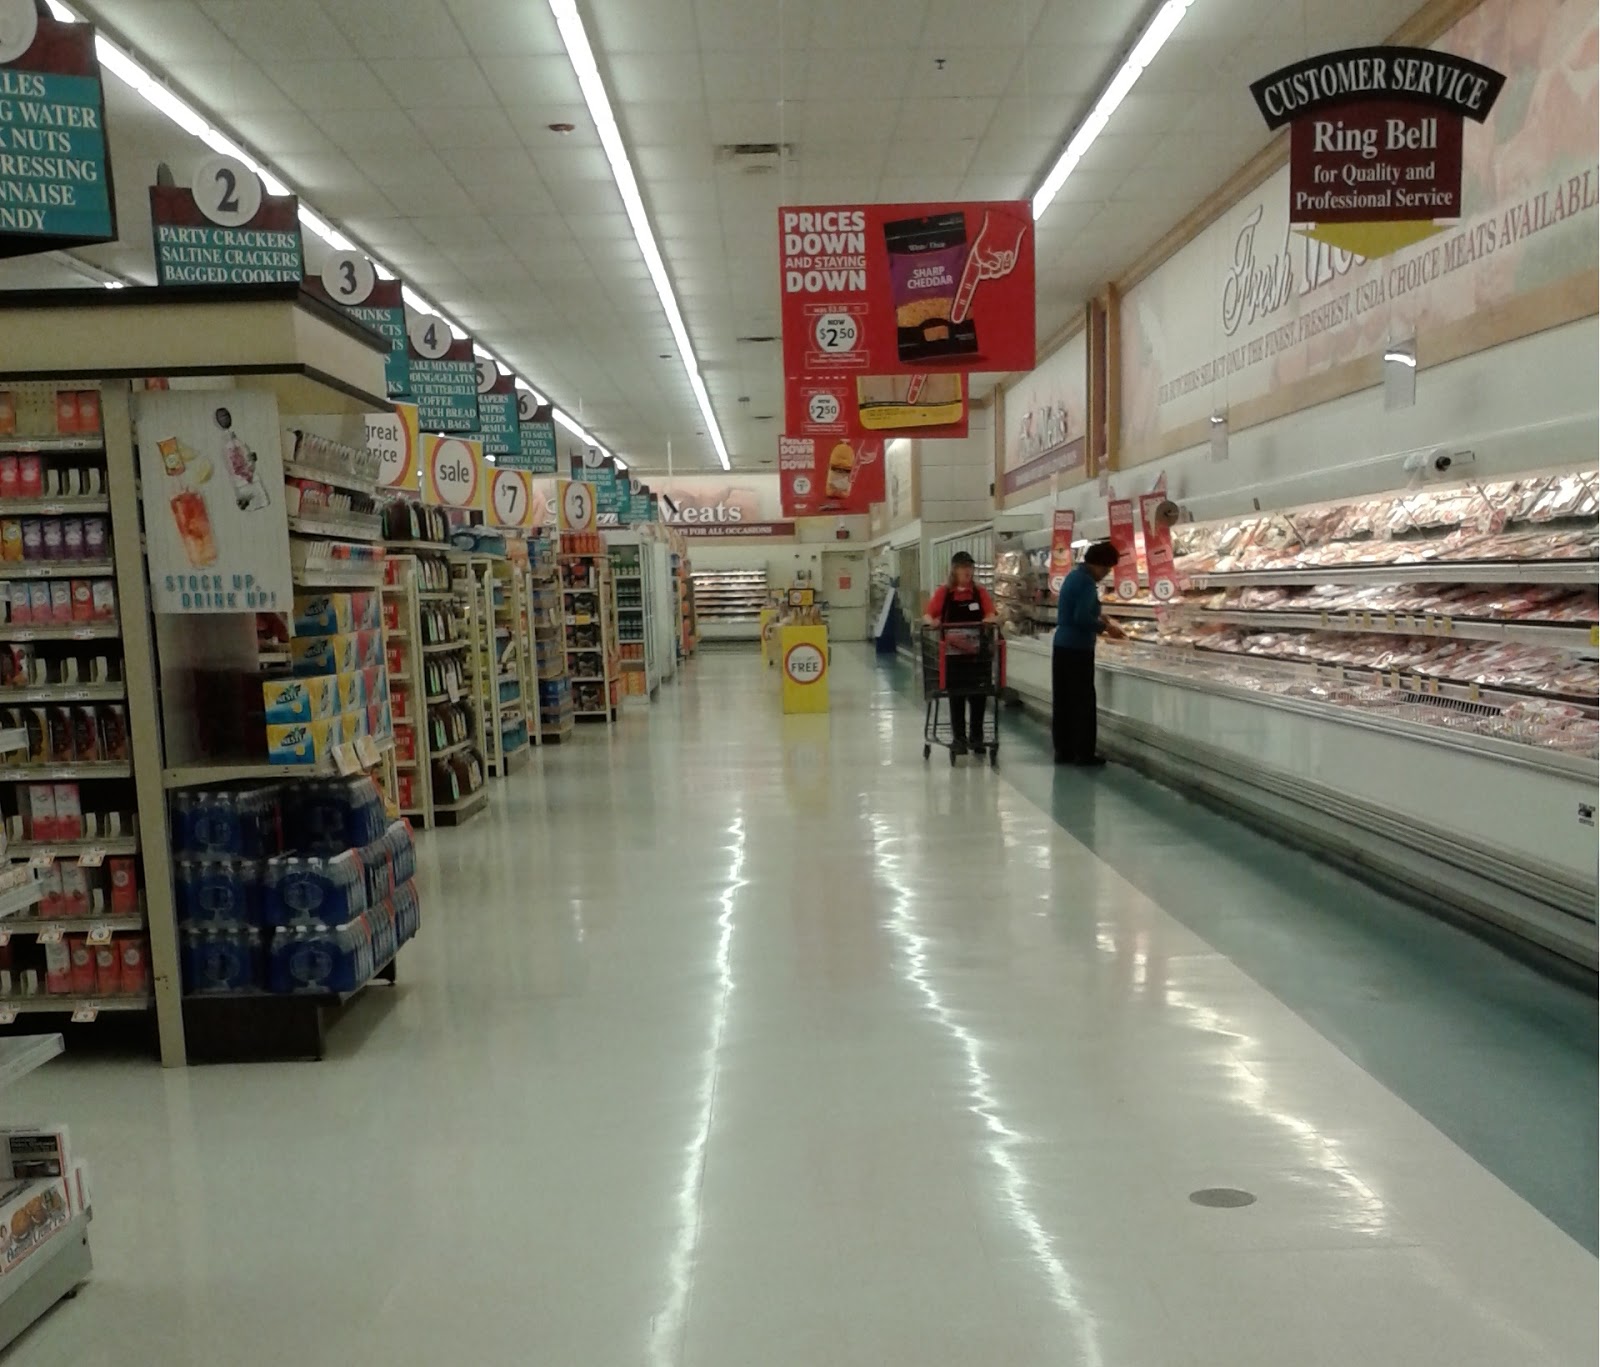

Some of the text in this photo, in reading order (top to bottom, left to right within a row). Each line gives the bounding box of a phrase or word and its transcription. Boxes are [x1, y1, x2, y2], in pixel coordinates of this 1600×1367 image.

[1264, 58, 1488, 116] CUSTOMER SERVICE
[19, 102, 98, 129] WATER
[12, 128, 72, 152] NUTS
[1313, 118, 1438, 160] Ring Bell
[1314, 161, 1435, 186] for Quality and
[215, 168, 239, 212] 2
[1295, 187, 1453, 210] Professional Service
[784, 210, 866, 233] PRICES
[160, 226, 297, 249] PARTY CRACKERS
[785, 232, 866, 256] DOWN
[1356, 278, 1386, 316] USDA
[1388, 246, 1441, 300] CHOICE
[1443, 218, 1497, 275] MEATS
[1499, 164, 1599, 249] AVAILABL
[162, 245, 300, 267] SALTINE CRACKERS
[785, 256, 866, 269] AND STAYING
[165, 265, 301, 283] BAGGED COOKIES
[339, 260, 357, 295] 3
[786, 269, 867, 293] DOWN
[907, 274, 954, 289] CHEDDAR
[913, 265, 946, 279] SHARP
[423, 322, 437, 350] 4
[417, 396, 453, 406] COFFEE
[519, 394, 528, 416] 6
[446, 408, 477, 418] BREAD
[447, 419, 471, 429] BAGS
[469, 434, 502, 443] CEREAL
[485, 444, 509, 453] FOOD
[439, 460, 470, 484] sale
[502, 485, 518, 514] $7
[658, 500, 743, 523] Meats
[725, 526, 773, 535] OCCASIONS
[165, 574, 222, 592] STOCK
[181, 591, 277, 609] DRINK UP!
[791, 662, 819, 673] FREE
